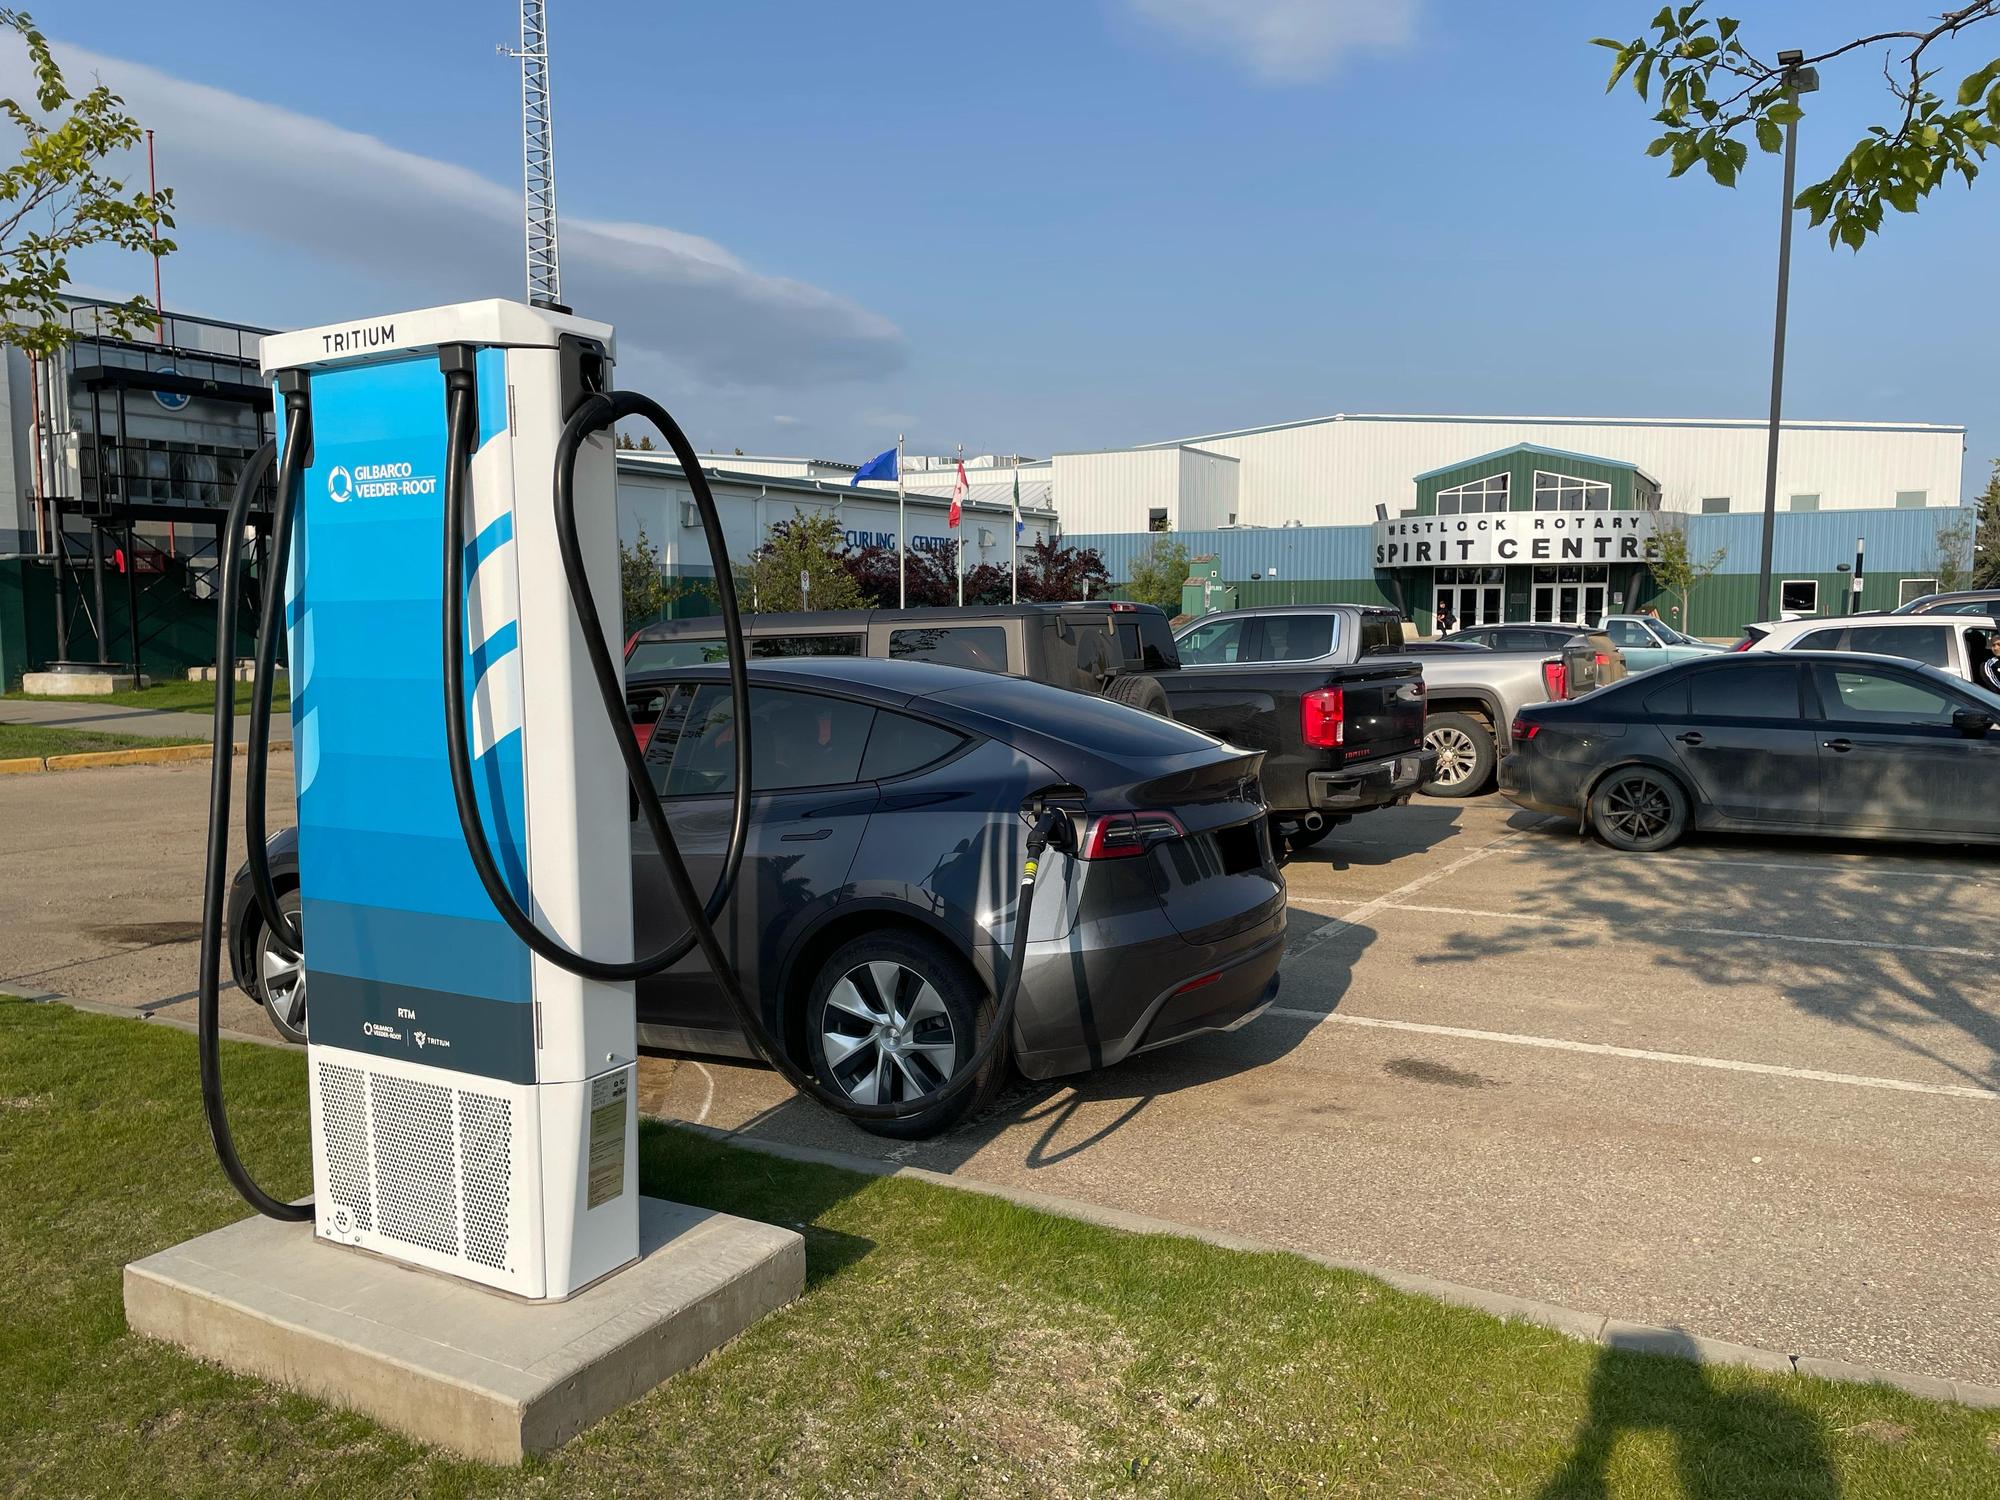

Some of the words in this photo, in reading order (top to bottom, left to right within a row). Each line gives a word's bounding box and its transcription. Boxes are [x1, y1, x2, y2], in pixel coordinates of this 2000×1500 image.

[322, 324, 395, 353] TRITIUM
[354, 462, 412, 481] GILBARCO
[354, 479, 437, 498] VEEDER-ROOT
[1388, 519, 1507, 536] WESTLOCK
[1534, 516, 1640, 530] ROTARY
[845, 530, 896, 551] CURLING
[1376, 540, 1475, 564] SPIRIT
[1497, 536, 1659, 559] CENTRE
[398, 1008, 416, 1020] RTM
[373, 1024, 394, 1032] GILBARCO
[373, 1030, 402, 1040] VEEDER-ROOT
[427, 1037, 450, 1047] TRITIUM
